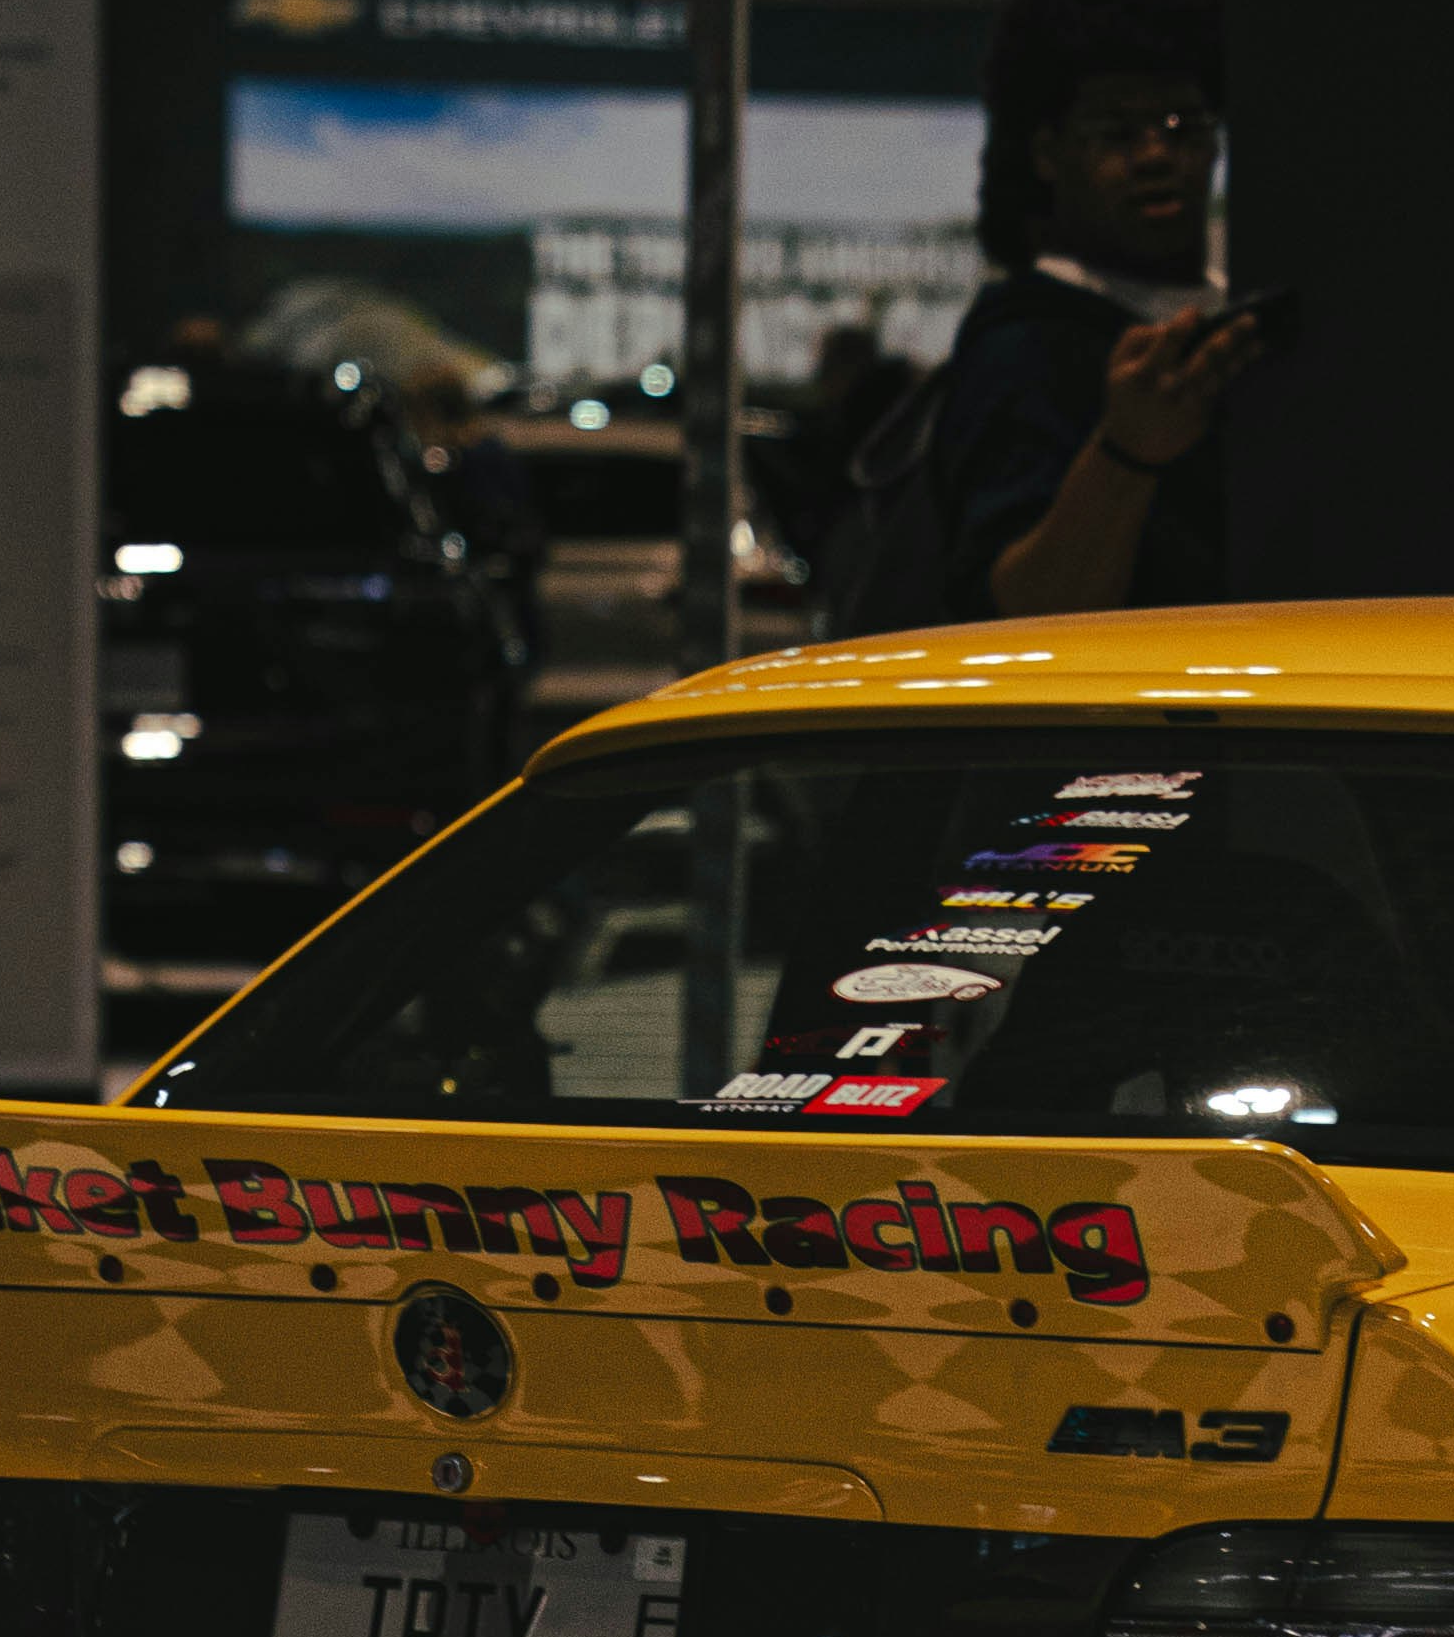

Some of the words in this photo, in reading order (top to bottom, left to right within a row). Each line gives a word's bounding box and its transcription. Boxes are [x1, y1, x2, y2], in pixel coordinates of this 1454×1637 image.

[865, 938, 1040, 956] Performance
[715, 1073, 833, 1099] ROAD
[824, 1083, 920, 1107] BLITZ
[204, 1159, 631, 1288] Bunny
[655, 1175, 1150, 1305] Racing
[1105, 1407, 1291, 1461] M3
